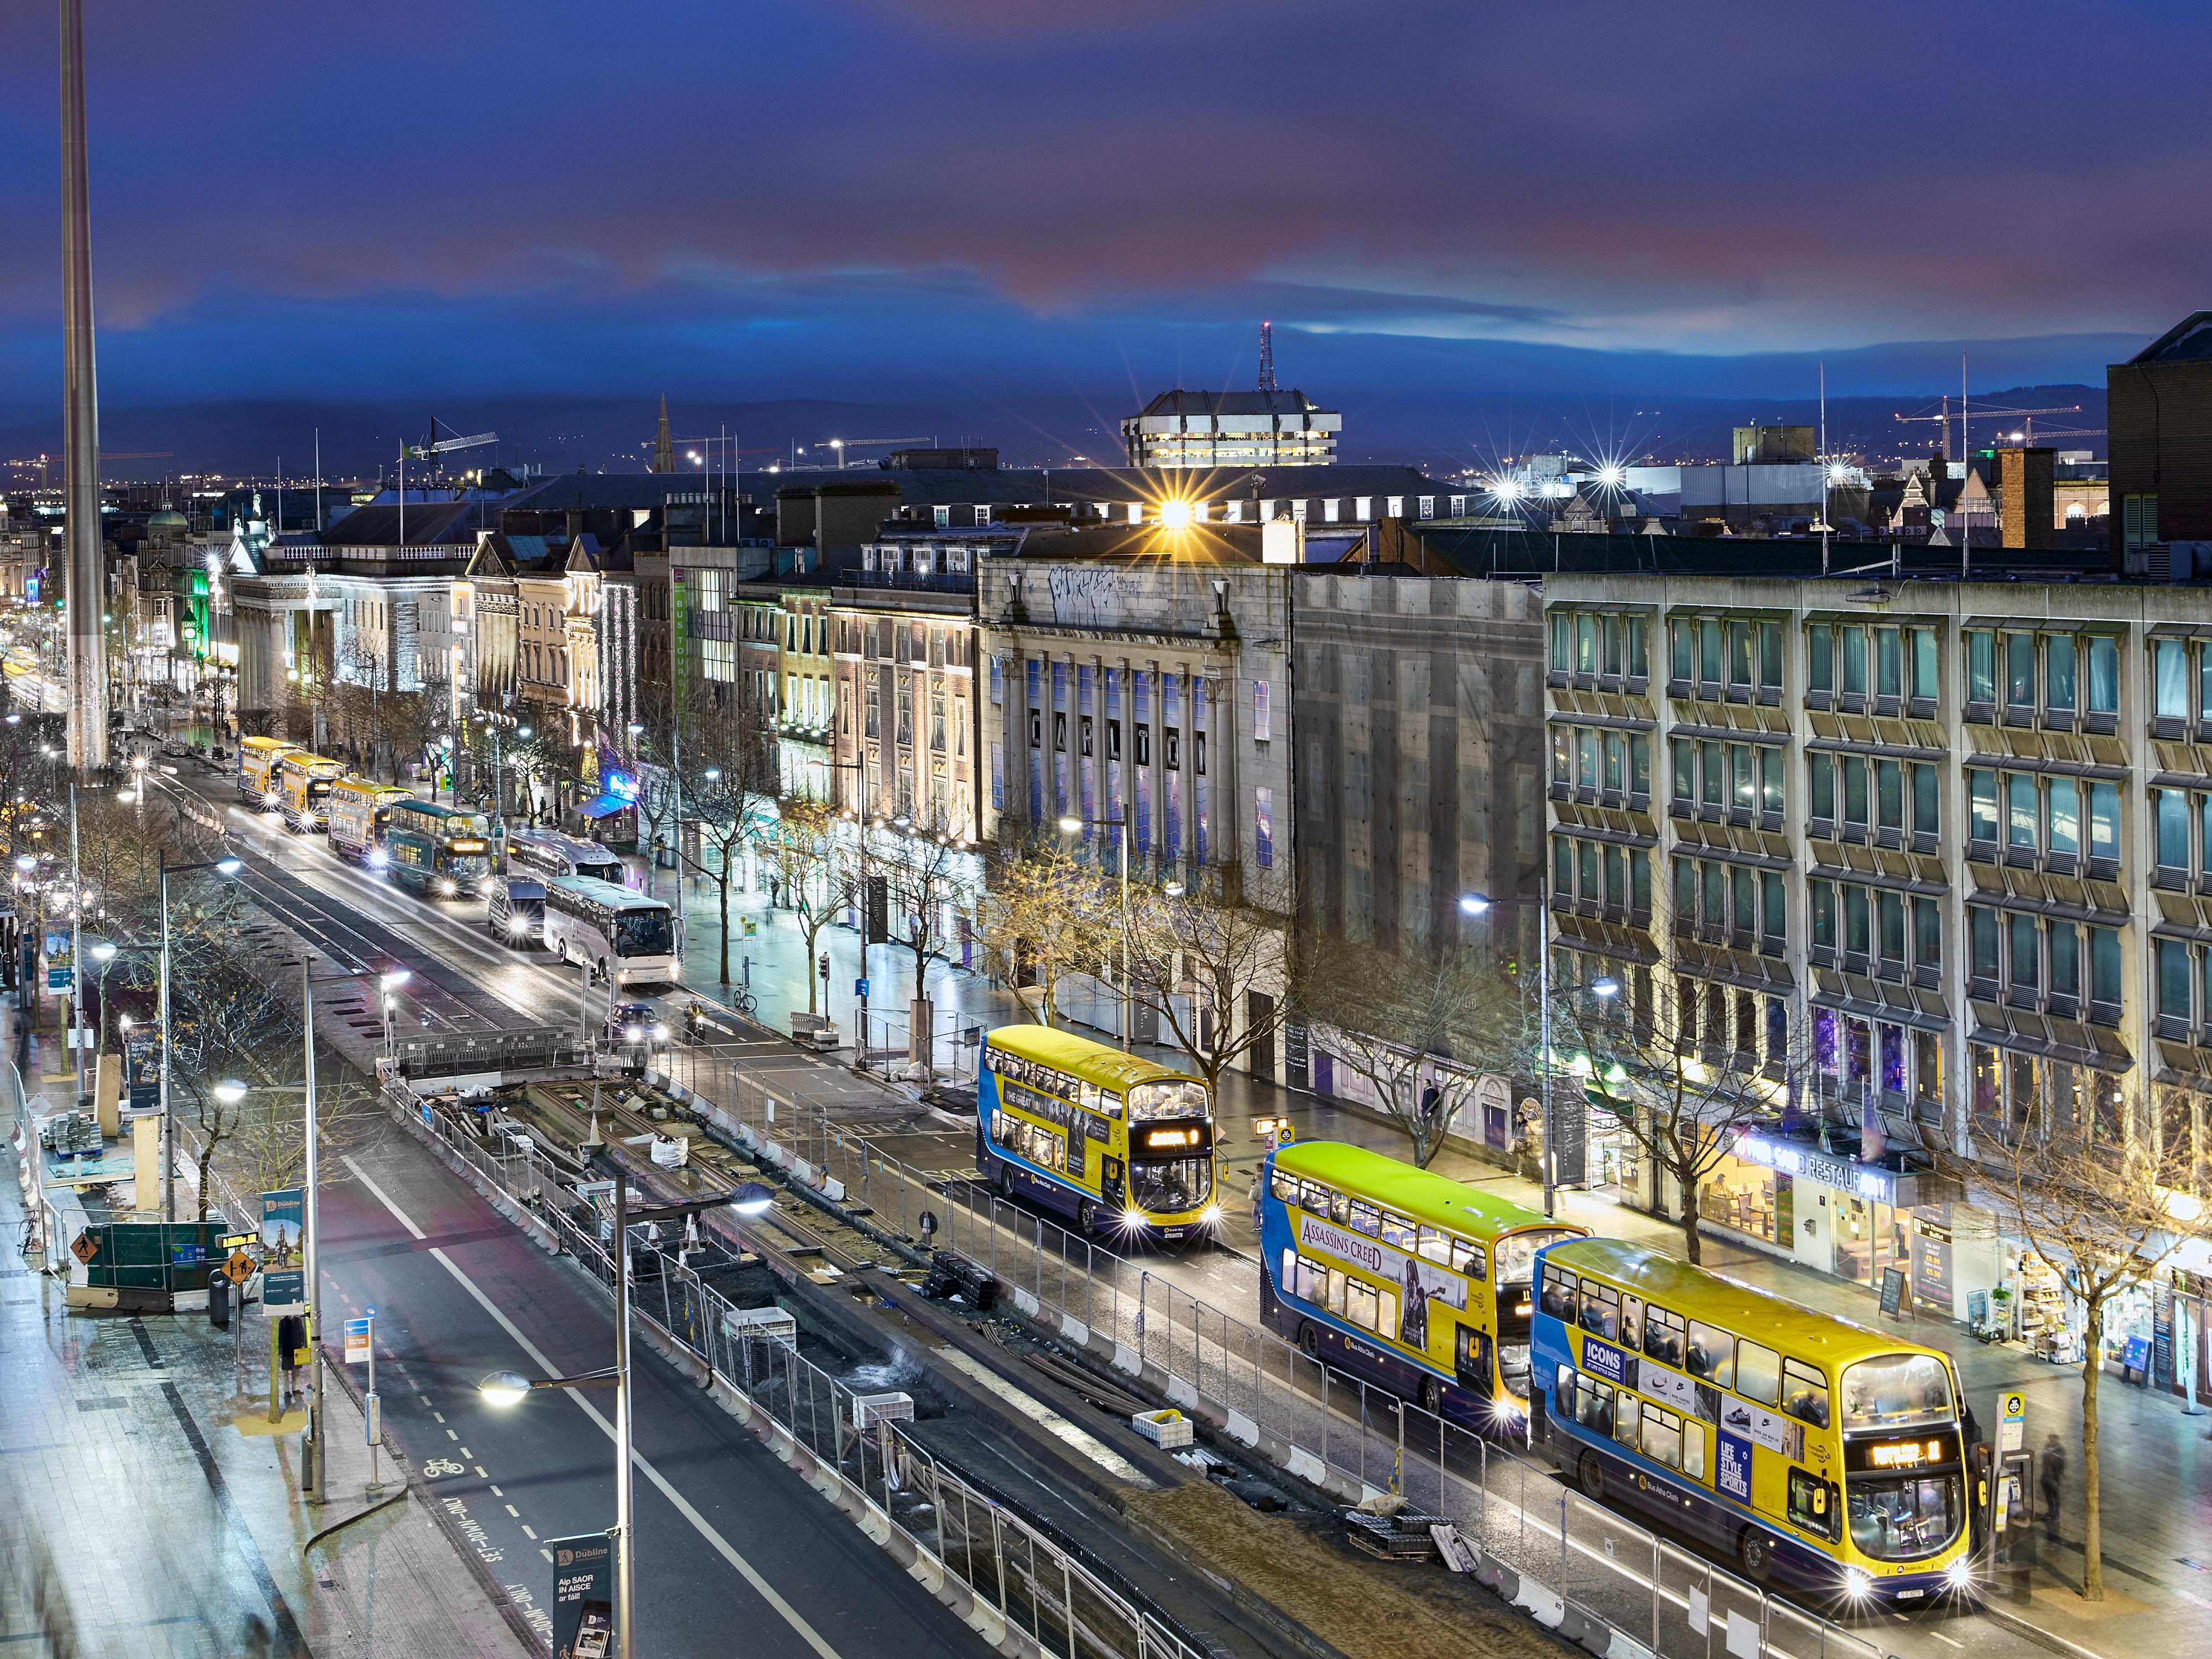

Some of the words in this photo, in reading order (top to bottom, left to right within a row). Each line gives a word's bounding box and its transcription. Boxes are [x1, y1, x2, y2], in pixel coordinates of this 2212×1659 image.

[1007, 1091, 1015, 1102] THE
[1016, 1094, 1031, 1108] GREAT
[1032, 1100, 1044, 1112] WALL
[1073, 1155, 1083, 1163] CINEMAS
[1808, 1157, 1887, 1201] RESTAURANT
[1920, 1220, 1929, 1229] Ten
[1302, 1220, 1349, 1253] ASSASSINS
[1351, 1241, 1381, 1271] CREED
[1925, 1254, 1940, 1265] €9.99
[1926, 1267, 1941, 1279] €5.50
[1588, 1342, 1620, 1370] ICONS
[1598, 1366, 1607, 1375] STYLE
[1607, 1370, 1620, 1380] SPORTS
[1721, 1441, 1734, 1457] LIFE
[1808, 1443, 1824, 1454] Transport
[1812, 1451, 1824, 1460] Ireland
[1928, 1441, 1940, 1460] 11
[1721, 1457, 1742, 1475] STYLE
[1720, 1472, 1747, 1494] SPORTS
[1647, 1481, 1656, 1491] Bus
[1656, 1484, 1666, 1496] Átha
[1666, 1491, 1679, 1503] Cliath
[575, 1548, 608, 1558] Dubline
[572, 1574, 593, 1584] SAOR
[568, 1583, 591, 1593] AISCE
